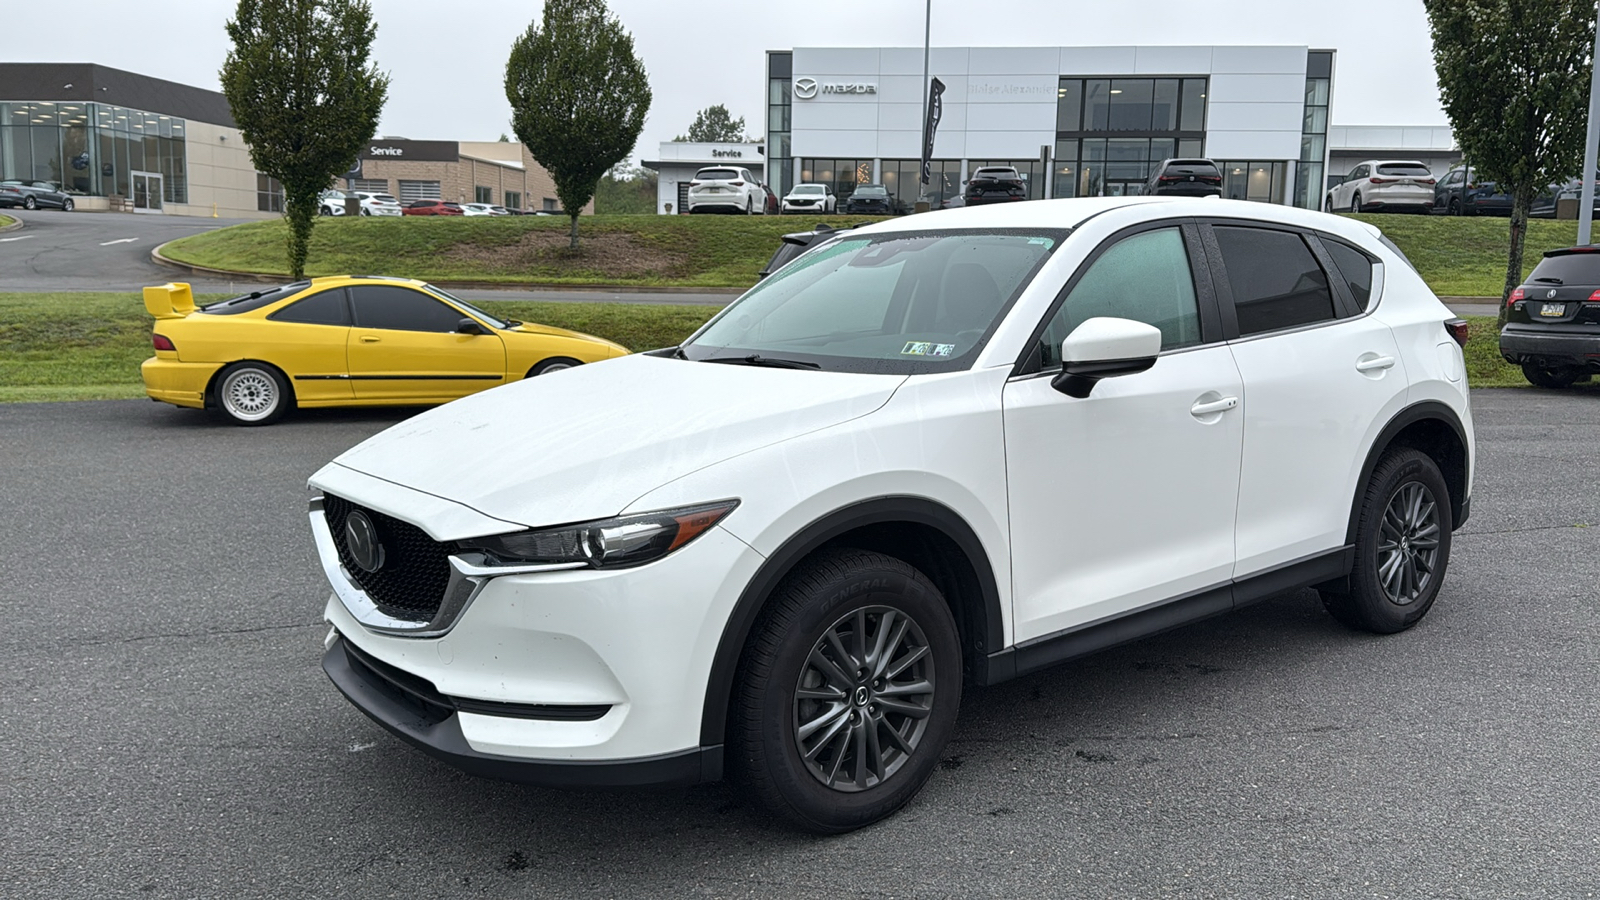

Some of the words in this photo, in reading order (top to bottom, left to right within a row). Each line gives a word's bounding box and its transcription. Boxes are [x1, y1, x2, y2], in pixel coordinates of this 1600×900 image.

[370, 146, 403, 156] Service
[712, 149, 742, 158] Service
[820, 578, 889, 612] GENERAL
